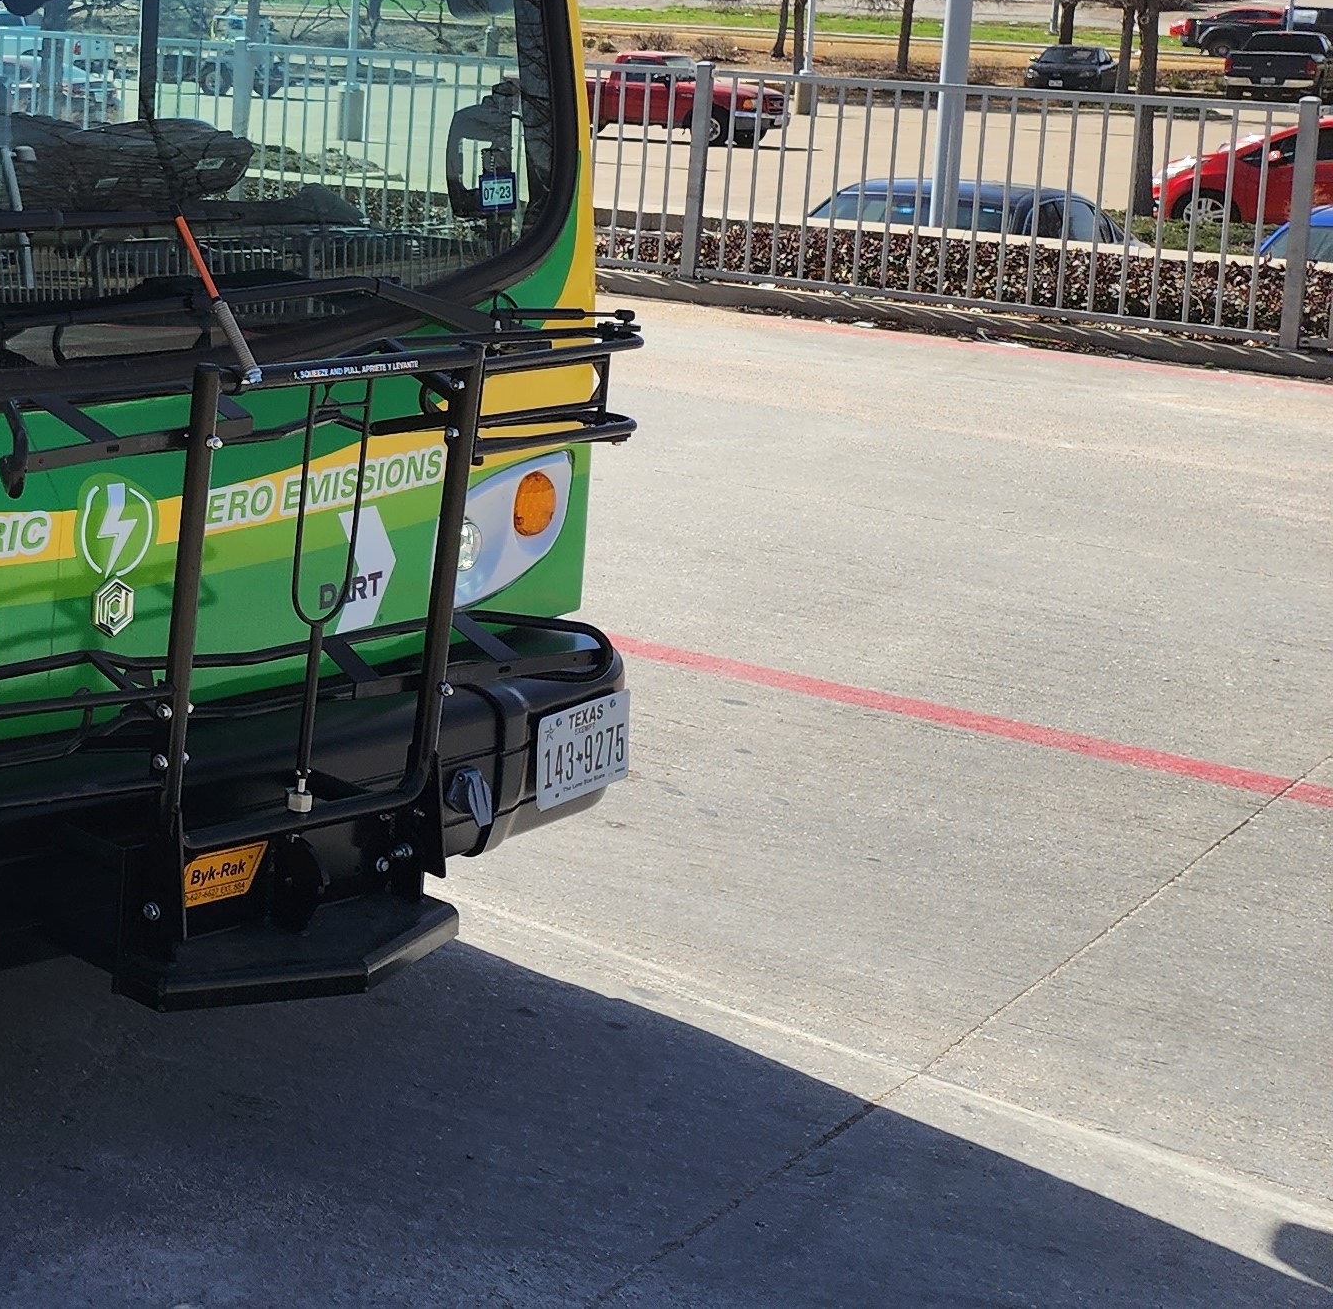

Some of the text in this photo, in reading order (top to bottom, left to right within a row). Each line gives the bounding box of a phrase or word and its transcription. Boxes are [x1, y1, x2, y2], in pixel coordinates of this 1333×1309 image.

[483, 186, 511, 200] 07 23
[207, 448, 443, 525] ERO EMISSIONS
[568, 704, 604, 730] TEXAS
[190, 858, 247, 887] Byk-Rak
